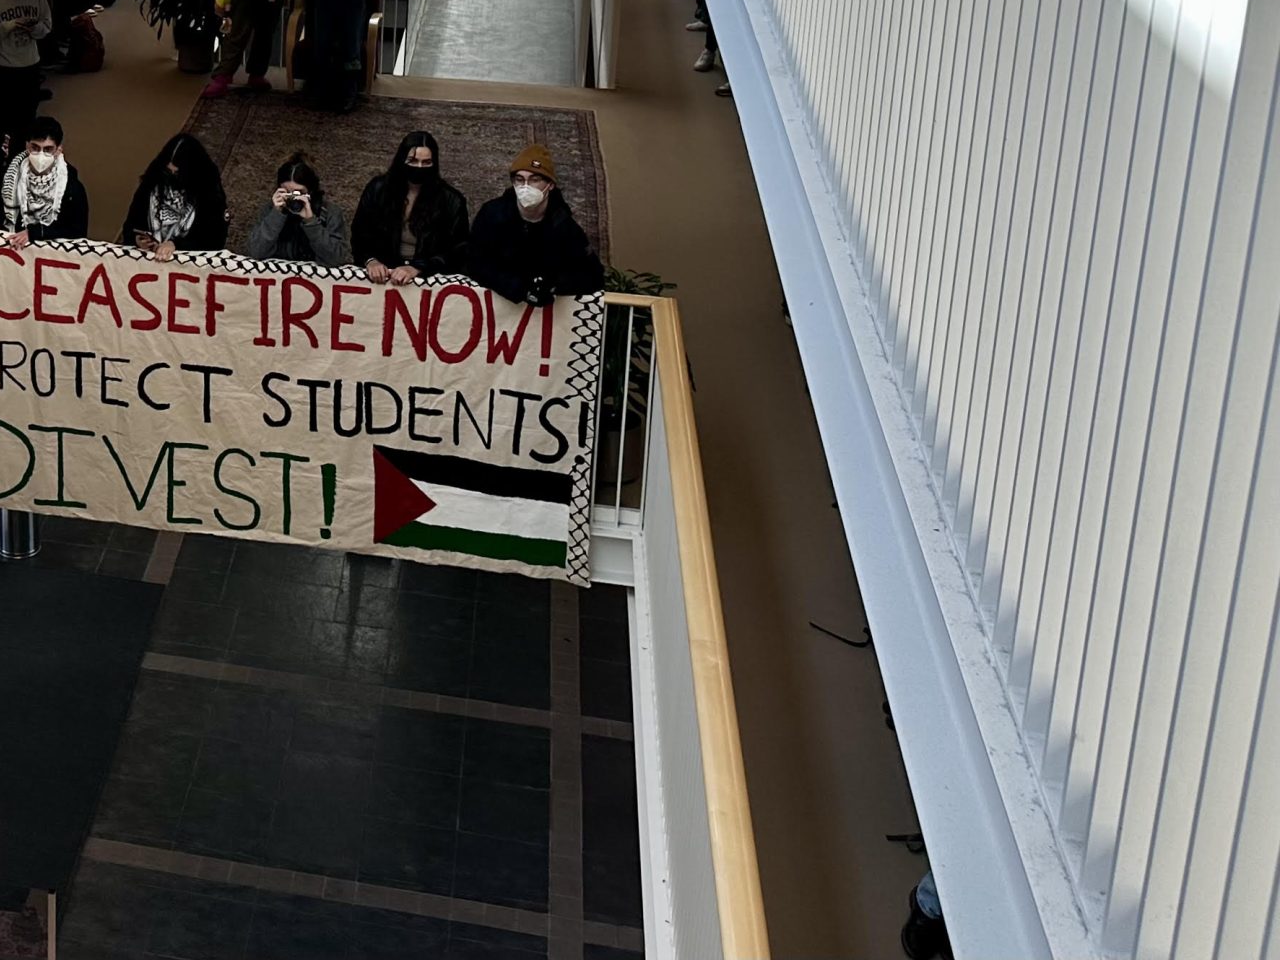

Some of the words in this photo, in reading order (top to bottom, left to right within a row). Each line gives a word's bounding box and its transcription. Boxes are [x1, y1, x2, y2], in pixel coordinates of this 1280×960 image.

[1, 5, 39, 22] BROWN
[381, 283, 554, 377] NOW!
[261, 371, 590, 465] STUDENTS!
